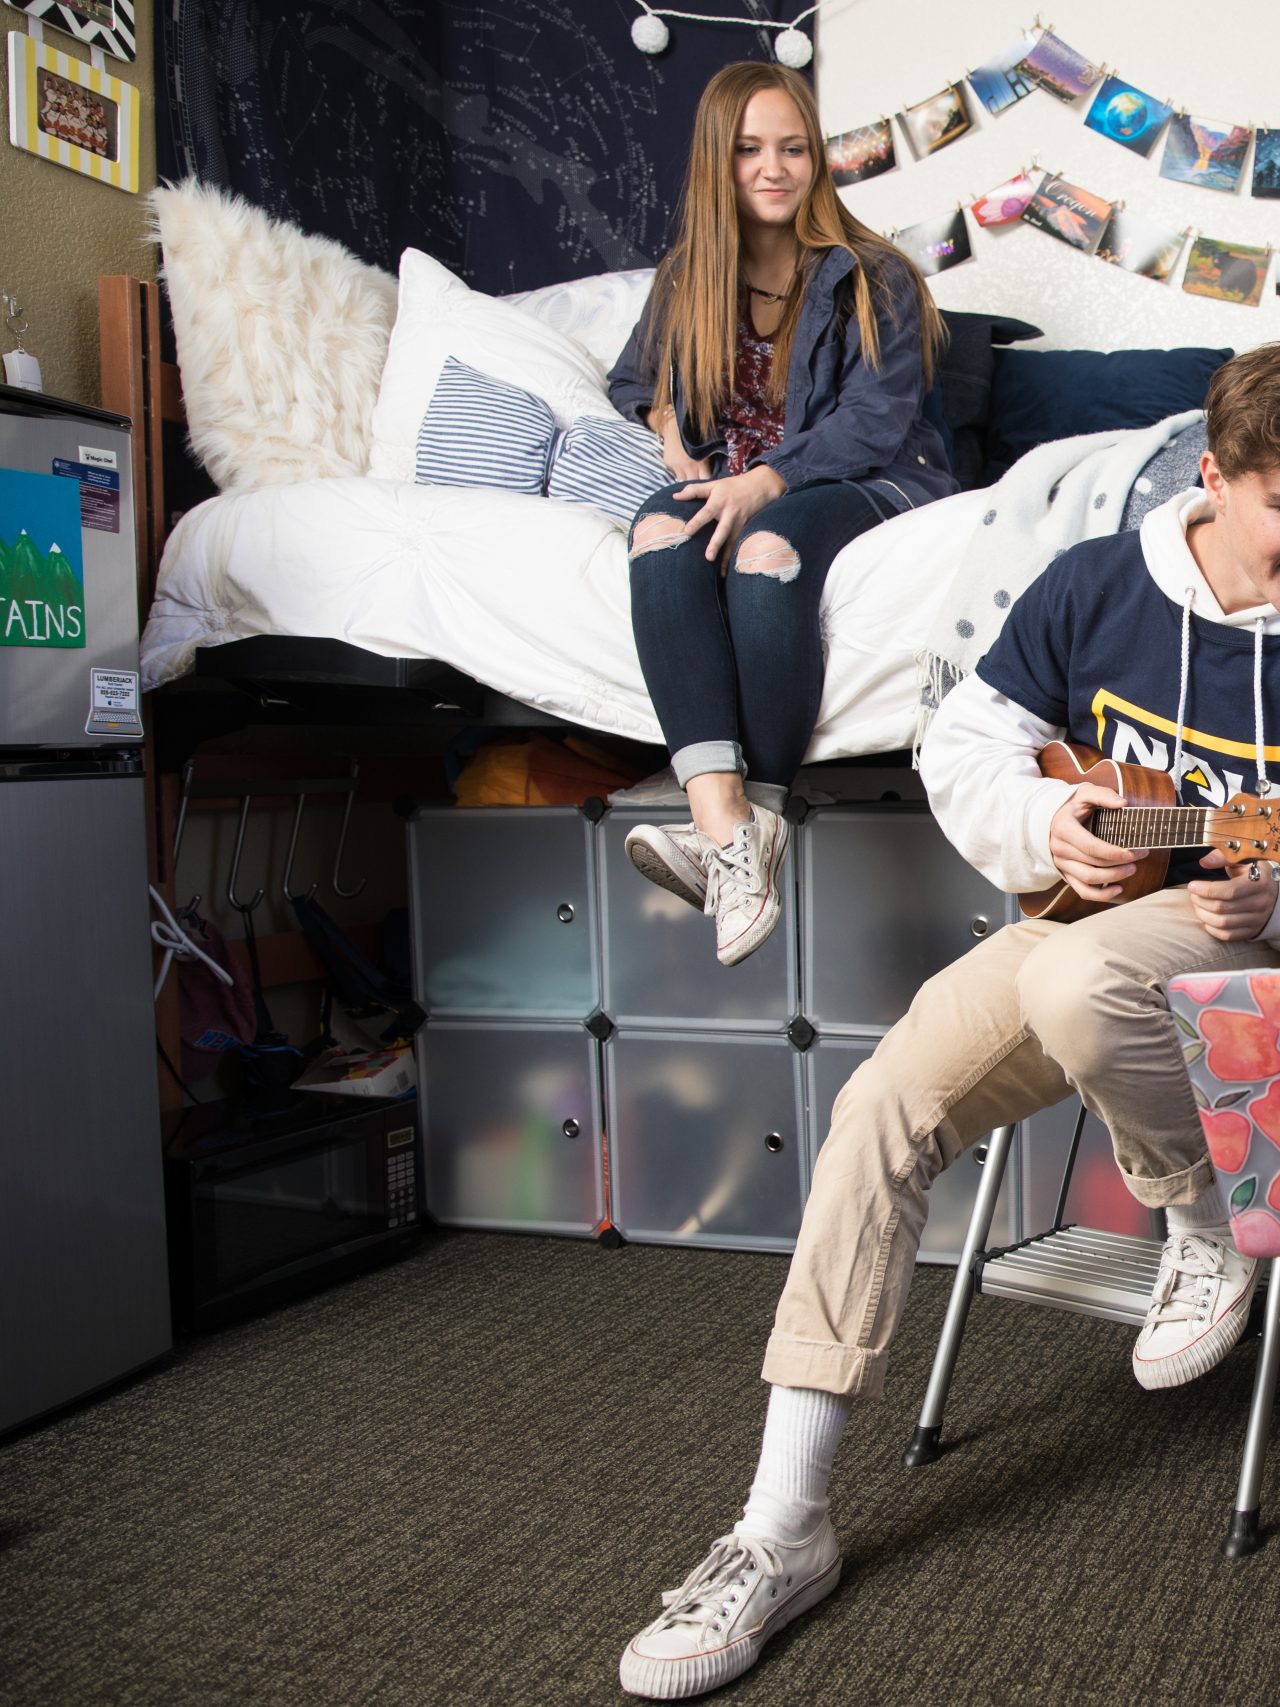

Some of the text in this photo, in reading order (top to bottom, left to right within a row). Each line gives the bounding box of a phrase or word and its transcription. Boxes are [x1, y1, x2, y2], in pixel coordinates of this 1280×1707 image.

[453, 20, 496, 31] PEGASUS
[444, 80, 486, 91] LACERTA
[496, 85, 551, 123] ANDROMEDA
[1045, 181, 1097, 218] Oregon
[90, 455, 103, 463] Magic
[0, 597, 82, 640] AINS
[97, 674, 133, 684] LUMBERJACK
